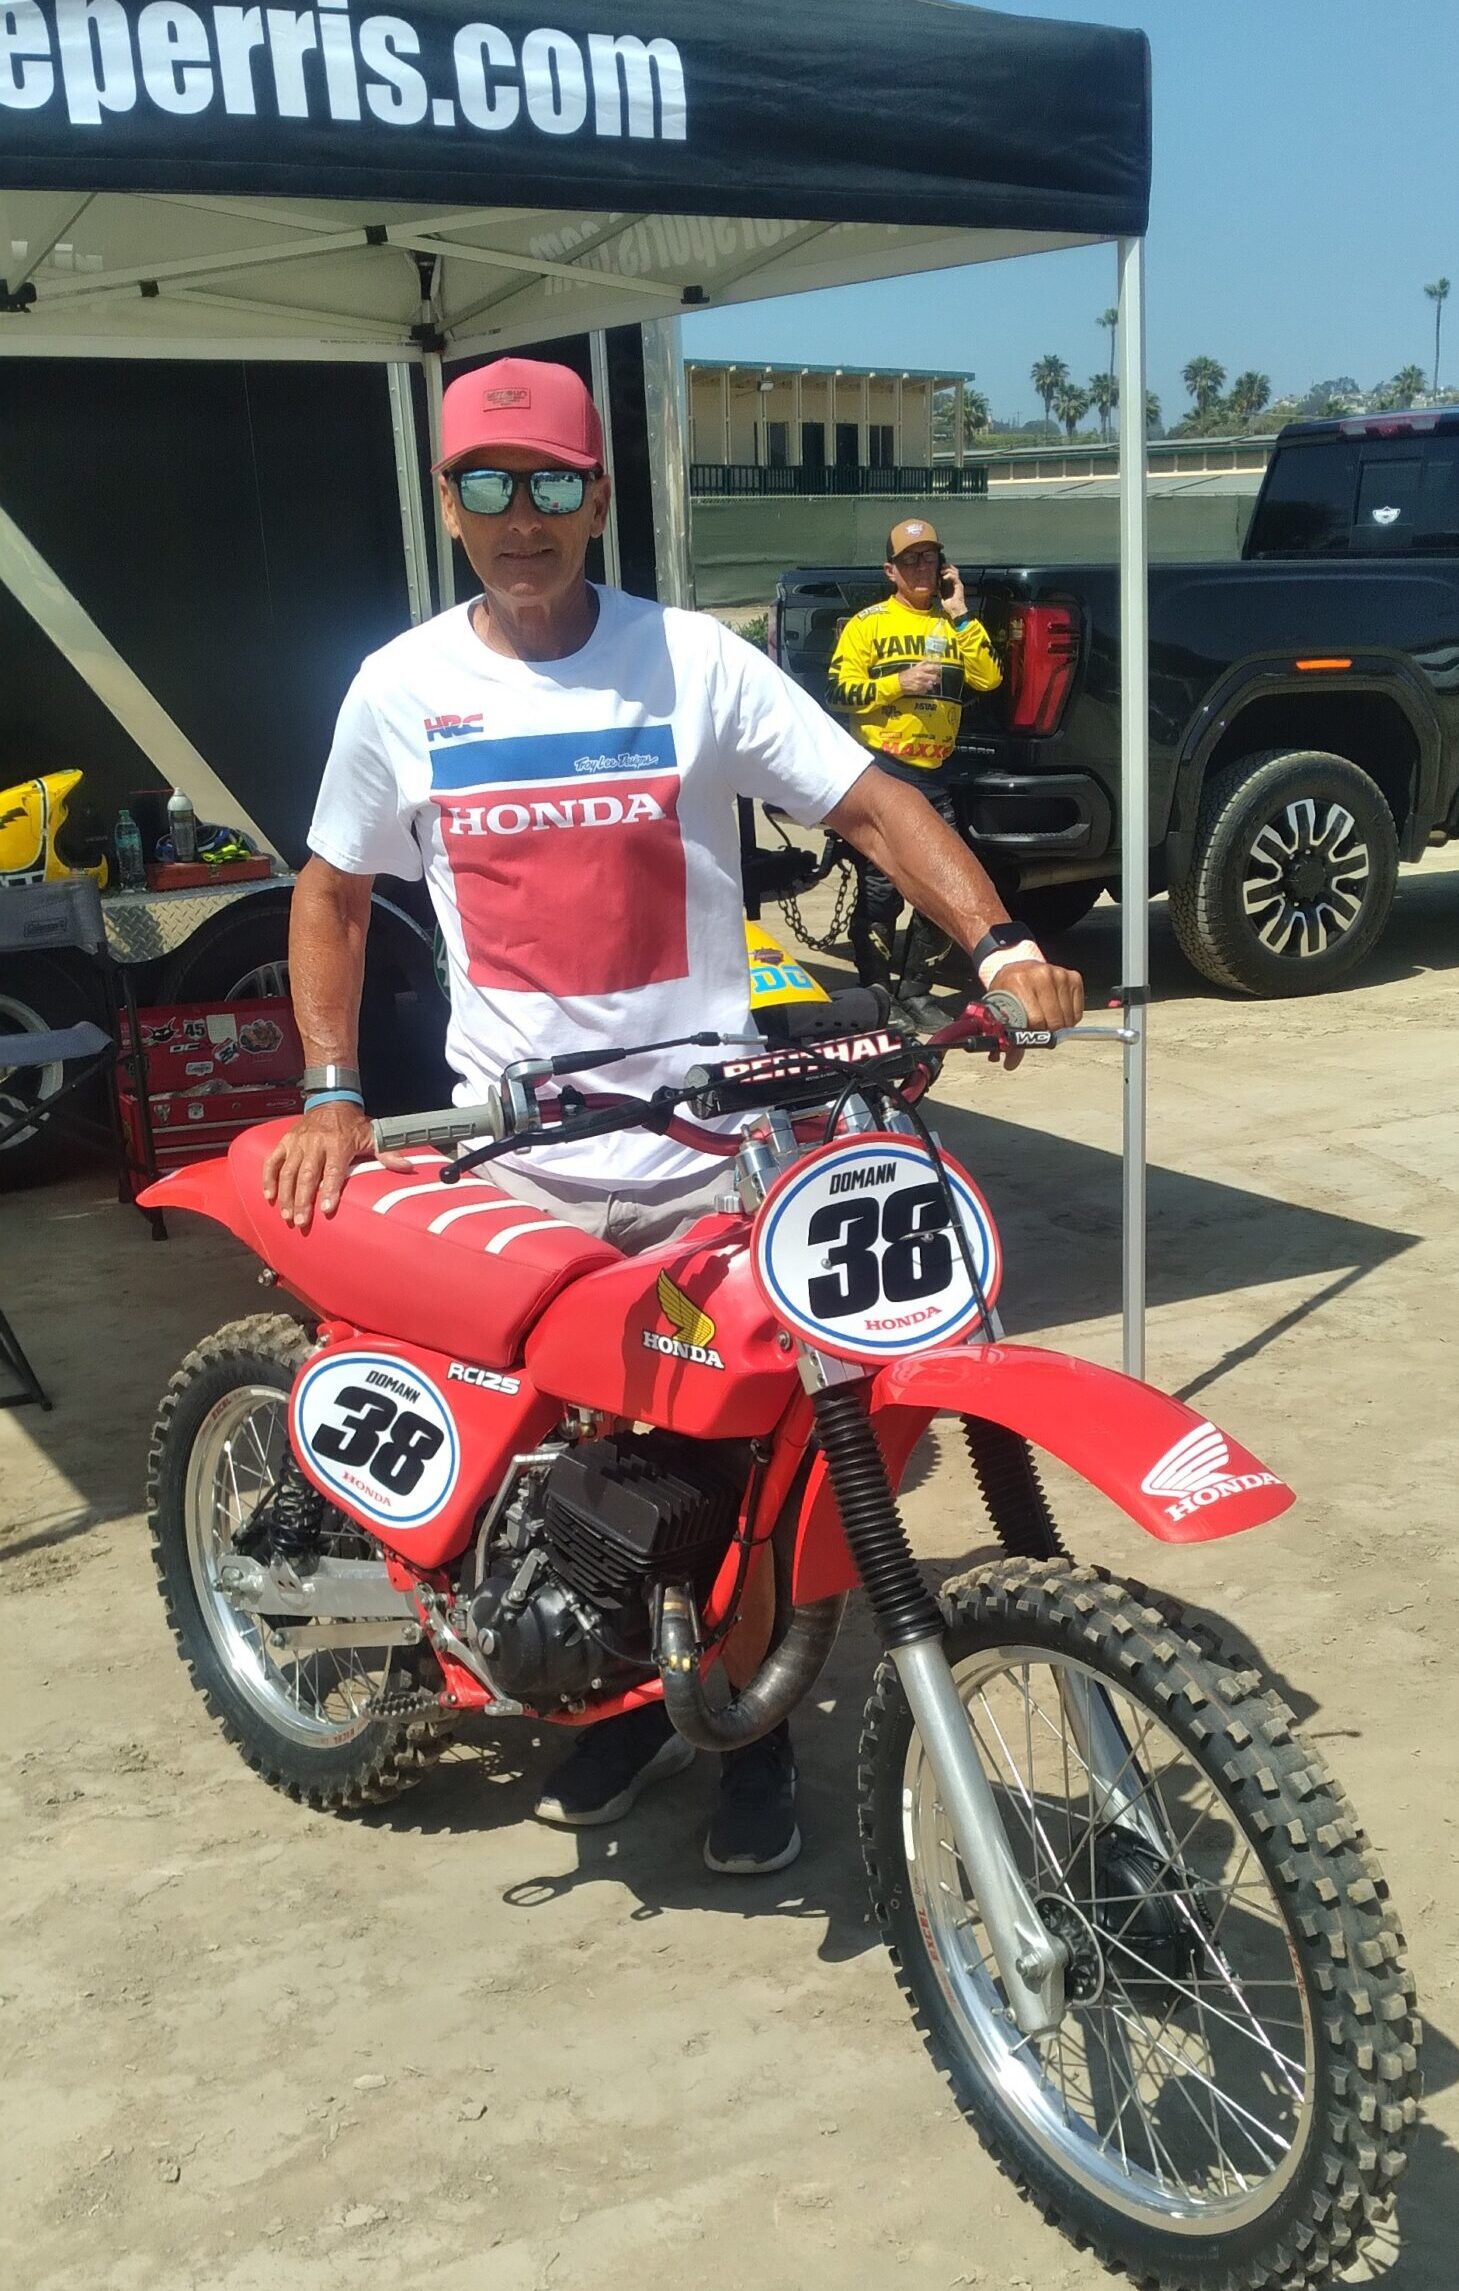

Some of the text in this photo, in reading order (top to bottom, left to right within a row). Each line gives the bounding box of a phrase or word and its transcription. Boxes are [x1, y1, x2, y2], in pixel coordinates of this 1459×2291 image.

[872, 634, 966, 660] YAMH
[424, 713, 484, 742] HRC
[574, 756, 598, 773] Troy
[599, 755, 617, 769] Lee
[448, 793, 666, 836] HONDA
[829, 1162, 896, 1195] DOMANN
[808, 1181, 953, 1319] 38
[864, 1306, 943, 1331] HONDA
[642, 1330, 725, 1370] HONDA
[365, 1370, 421, 1404] DOMANN
[311, 1385, 445, 1496] 38
[342, 1471, 392, 1507] HONDA
[1164, 1472, 1288, 1522] HONDA
